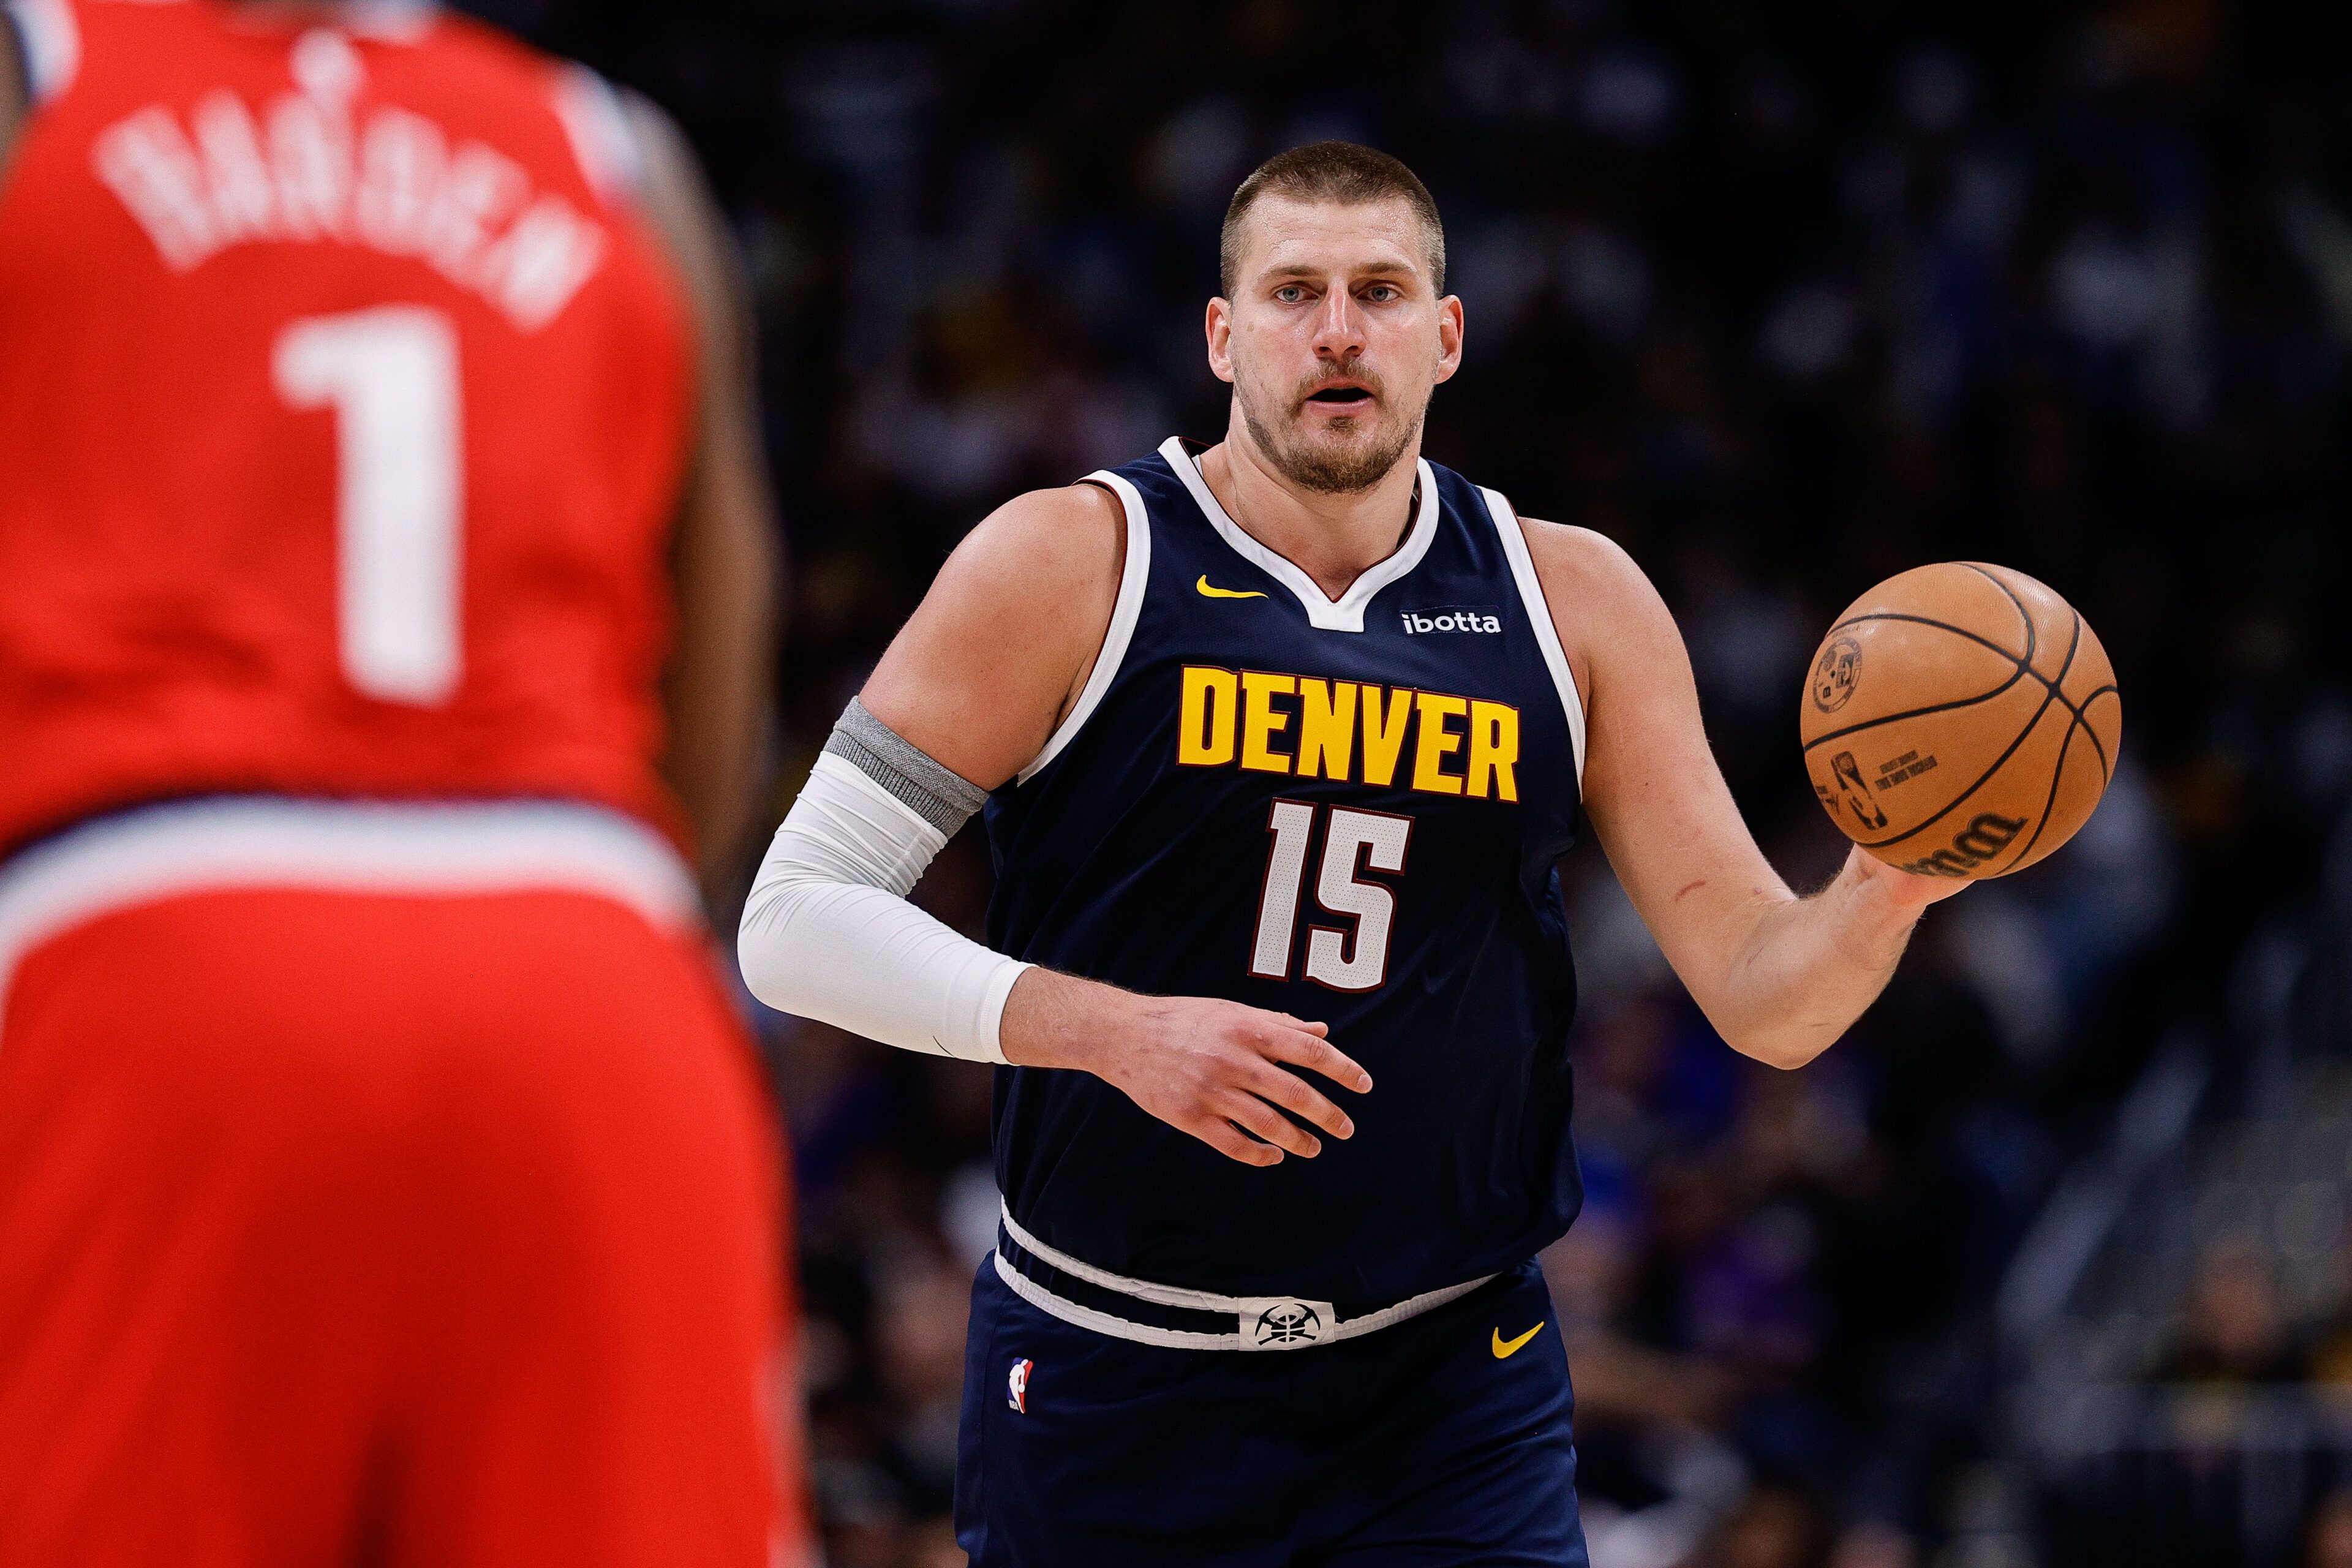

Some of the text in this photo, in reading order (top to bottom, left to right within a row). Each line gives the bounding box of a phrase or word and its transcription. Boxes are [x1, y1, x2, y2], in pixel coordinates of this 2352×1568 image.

[270, 304, 464, 707] 1
[1401, 612, 1501, 634] ibotta
[1176, 664, 1520, 804] DENVER
[1248, 797, 1415, 993] 15
